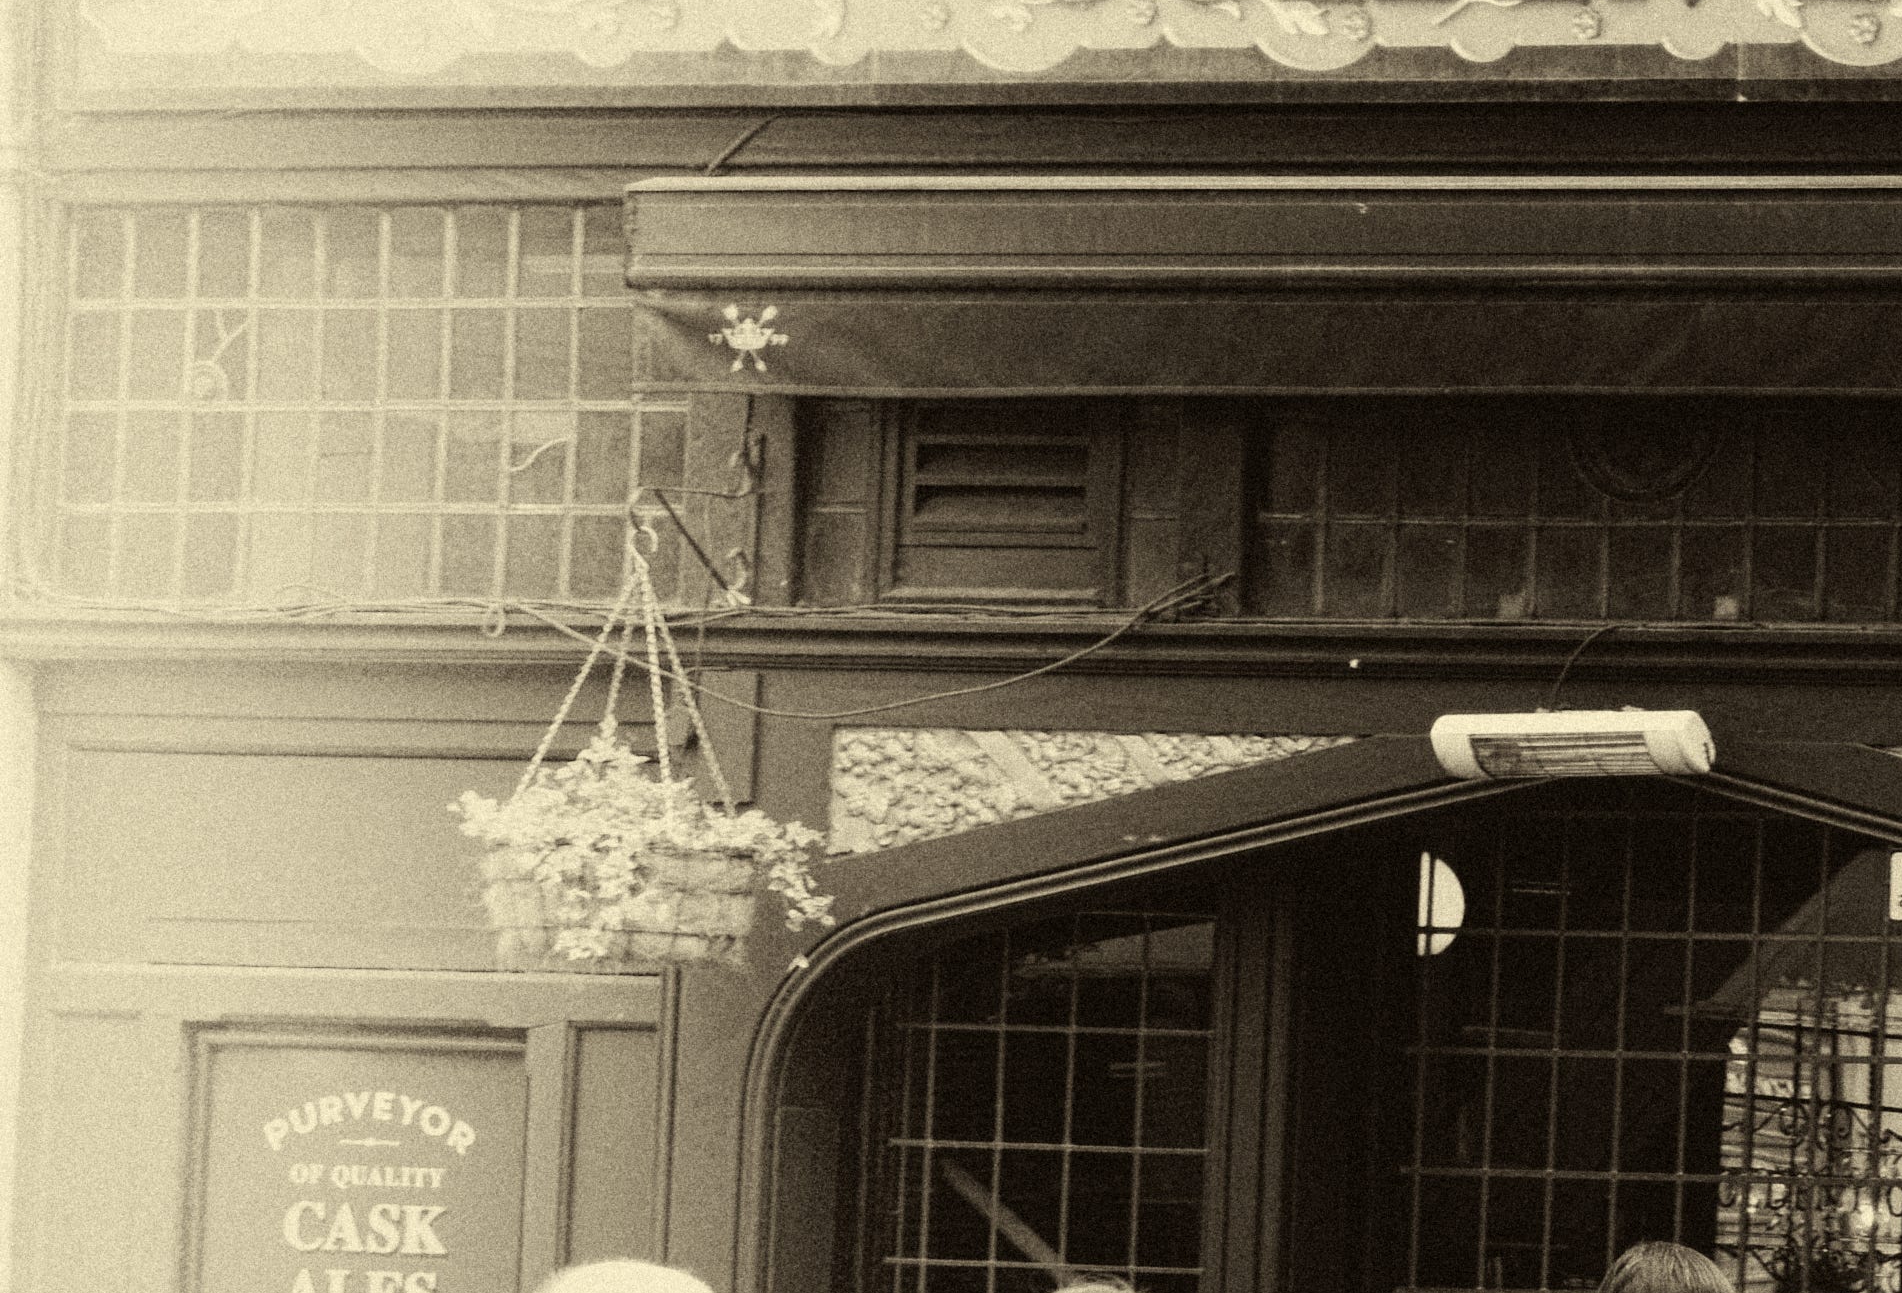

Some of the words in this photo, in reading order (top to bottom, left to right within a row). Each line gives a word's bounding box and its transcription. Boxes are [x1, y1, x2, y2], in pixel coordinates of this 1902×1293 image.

[263, 1091, 476, 1154] PURVEYOR
[289, 1163, 323, 1185] OF
[330, 1164, 447, 1189] QUALITY
[283, 1200, 448, 1255] CASK
